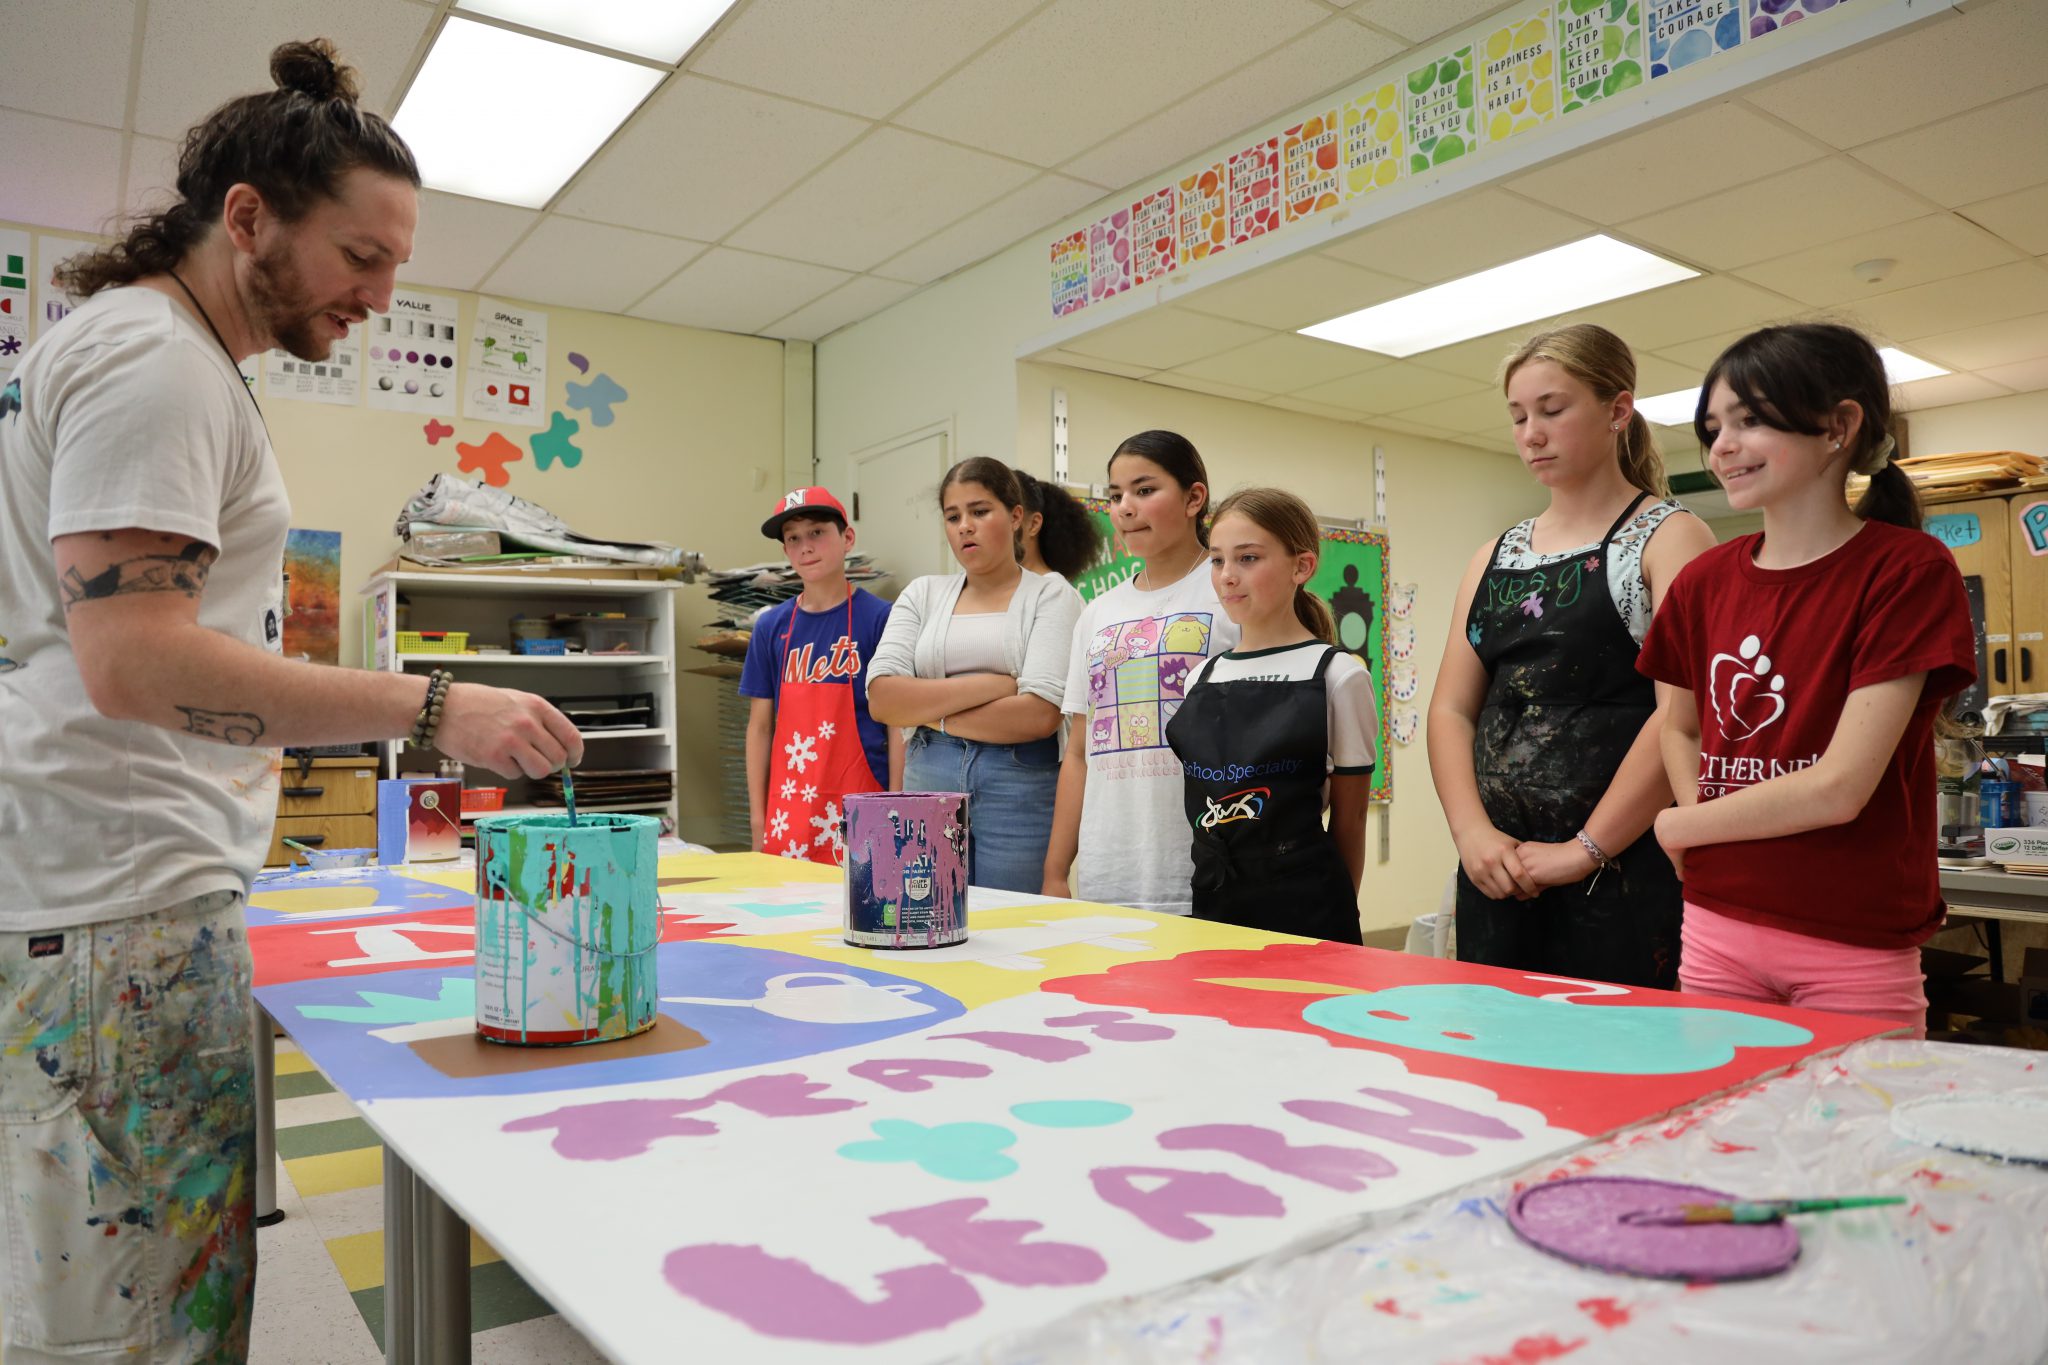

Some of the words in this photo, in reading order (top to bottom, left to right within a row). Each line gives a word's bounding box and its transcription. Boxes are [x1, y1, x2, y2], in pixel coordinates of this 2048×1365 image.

[1658, 0, 1701, 19] TAKE
[1567, 7, 1604, 34] DON'T
[1659, 2, 1724, 39] COURAGE
[1568, 29, 1598, 51] STOP
[1487, 44, 1542, 76] HAPPINESS
[1569, 48, 1600, 70] KEEP
[1488, 82, 1499, 94] IS
[1506, 75, 1511, 86] A
[1570, 64, 1608, 88] GOING
[1415, 95, 1427, 108] DO
[1433, 83, 1453, 100] YOU
[1489, 88, 1523, 111] HABIT
[1415, 112, 1427, 125] BE
[1433, 101, 1453, 117] YOU
[1350, 122, 1367, 137] YOU
[1416, 126, 1435, 141] FOR
[1441, 115, 1460, 131] YOU
[1289, 132, 1332, 158] MISTAKES
[1350, 138, 1367, 152] ARE
[1234, 158, 1254, 175] DON'T
[1290, 159, 1305, 172] ARE
[1350, 146, 1387, 169] ENOUGH
[1234, 176, 1252, 189] WISH
[1255, 168, 1269, 180] FOR
[1290, 174, 1305, 188] FOR
[1184, 191, 1202, 207] DUST
[1234, 194, 1240, 204] IT
[1290, 178, 1335, 204] LEARNING
[1137, 198, 1170, 220] SOMETIMES
[1184, 199, 1216, 219] SETTLES
[1235, 204, 1253, 218] WORK
[1256, 197, 1270, 209] FOR
[1137, 223, 1149, 233] YOU
[1152, 214, 1166, 226] WIN
[1185, 222, 1198, 232] YOU
[1235, 223, 1241, 233] IT
[1095, 241, 1105, 251] YOU
[1137, 225, 1171, 247] SOMETIMES
[1055, 254, 1069, 265] YOUR
[1095, 254, 1105, 265] ARE
[1138, 249, 1149, 259] YOU
[1055, 261, 1082, 278] ATTITUDE
[1095, 263, 1115, 278] LOVED
[396, 300, 432, 312] VALUE
[494, 312, 524, 326] SPACE
[784, 488, 807, 512] N
[785, 636, 862, 684] Mets
[662, 1086, 1524, 1344] LEARN
